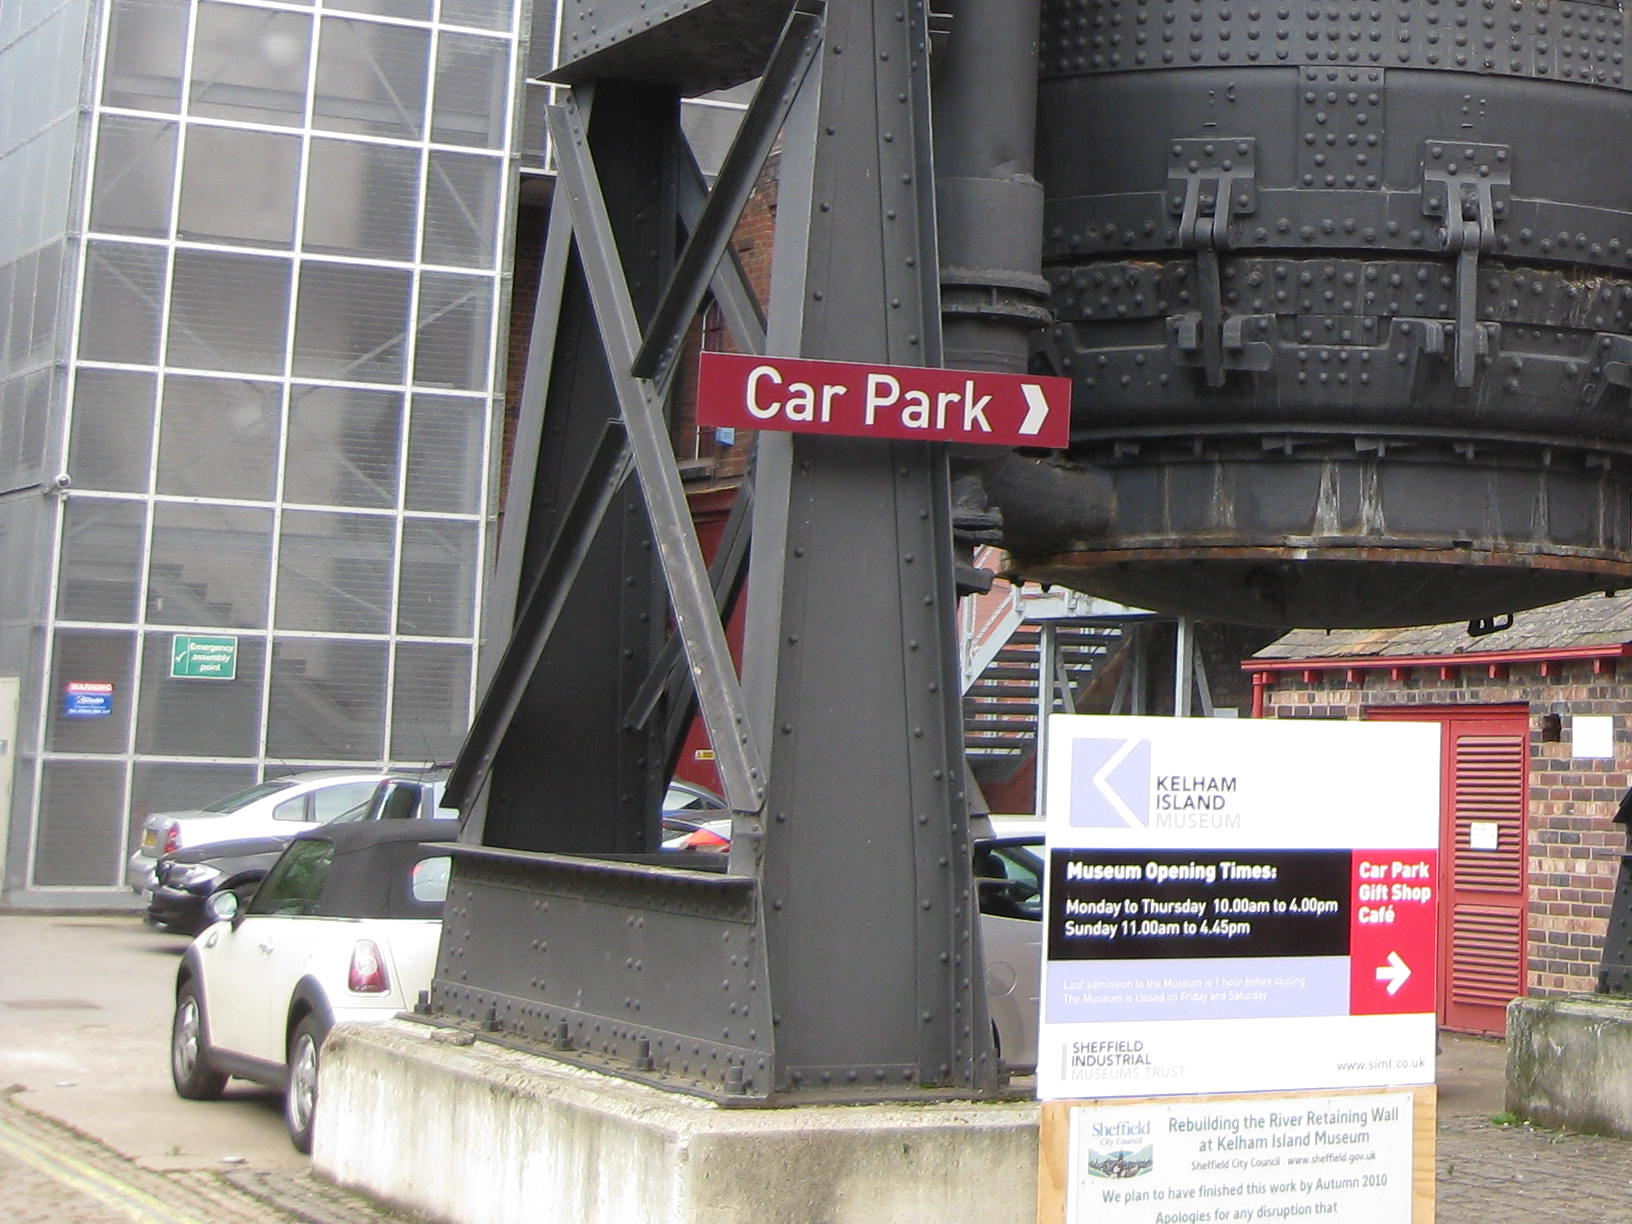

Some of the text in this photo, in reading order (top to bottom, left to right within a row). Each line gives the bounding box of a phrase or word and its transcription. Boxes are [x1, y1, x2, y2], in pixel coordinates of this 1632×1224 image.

[745, 365, 993, 433] Car Park
[190, 642, 234, 653] Emergency
[191, 654, 231, 663] assembly
[200, 664, 222, 672] point
[1156, 775, 1238, 792] KELHAM
[1156, 794, 1226, 810] ISLAND
[1156, 812, 1241, 829] MUSEUM
[1066, 860, 1277, 883] Museum Opening Times:
[1358, 860, 1430, 879] Car Park
[1358, 883, 1432, 904] Gift Shop
[1065, 897, 1339, 918] Monday to Thursday 10.00am to 4.00pm
[1358, 904, 1396, 924] Café
[1064, 919, 1251, 939] Sunday 11.00am to 4.45pm
[1063, 979, 1084, 990] Last
[1135, 979, 1145, 989] to
[1146, 978, 1161, 989] the
[1162, 977, 1203, 989] Museum
[1063, 993, 1081, 1004] The
[1082, 992, 1122, 1004] Museum
[1135, 991, 1166, 1003] closed
[1167, 993, 1179, 1002] on
[1180, 991, 1208, 1004] Friday
[1210, 991, 1227, 1001] and
[1228, 990, 1268, 1001] Saturday
[1072, 1040, 1144, 1054] SHEFFIELD
[1071, 1053, 1152, 1067] INDUSTRIAL
[1071, 1065, 1185, 1081] MUSEUMS TRUST
[1168, 1106, 1399, 1134] Rebuilding the River Retaining Wall
[1091, 1120, 1151, 1138] Sheffield
[1099, 1137, 1143, 1147] City Council
[1199, 1130, 1370, 1152] at Kelham Island Museum
[1191, 1158, 1230, 1171] Sheffield
[1231, 1157, 1248, 1170] City
[1250, 1157, 1281, 1168] Council
[1102, 1173, 1388, 1206] We plan to have finished this work by Autumn 2010
[1155, 1201, 1339, 1224] Apologies for any disruption that
